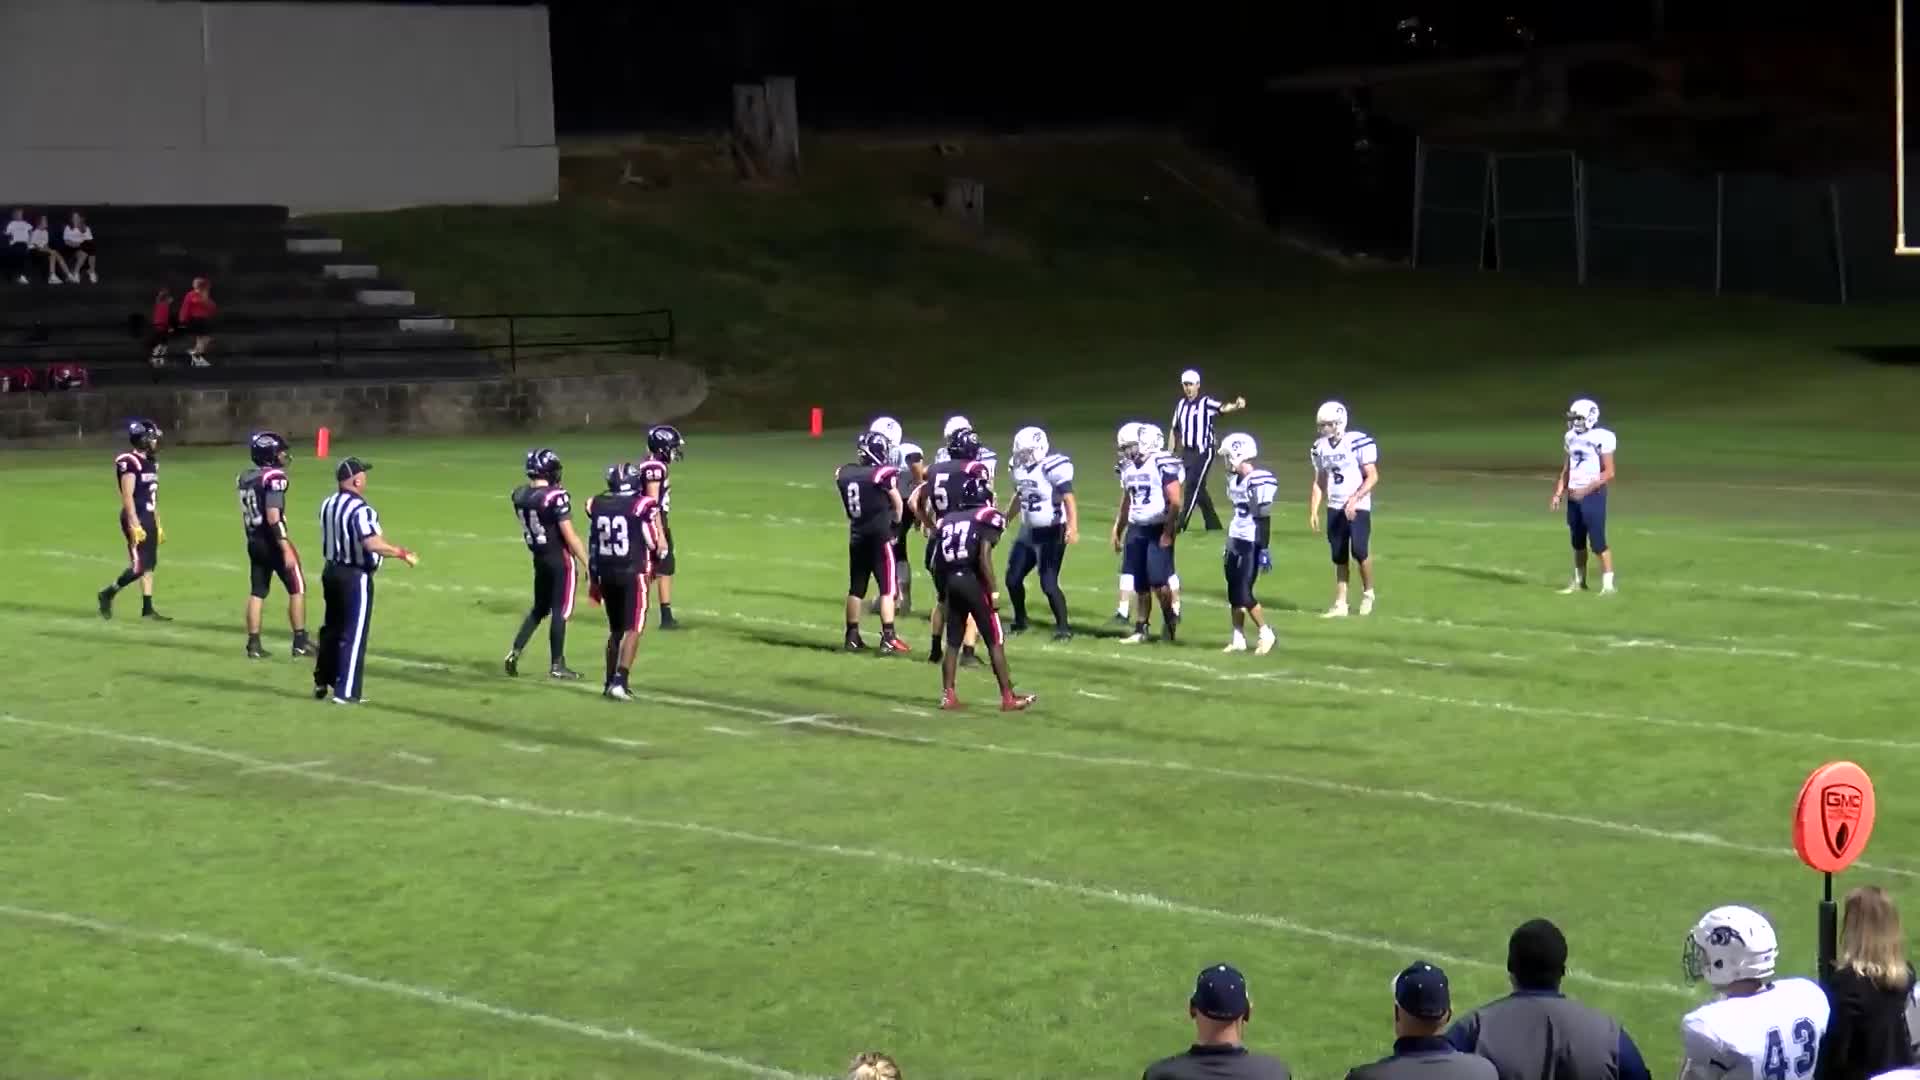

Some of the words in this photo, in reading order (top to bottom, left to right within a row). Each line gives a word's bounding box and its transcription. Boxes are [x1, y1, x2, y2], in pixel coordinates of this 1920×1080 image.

[146, 483, 158, 511] 3
[847, 482, 862, 519] 8
[933, 472, 950, 511] 5
[597, 515, 629, 556] 23
[941, 520, 971, 562] 27
[1827, 792, 1861, 808] GMC
[1762, 1016, 1817, 1080] 43
